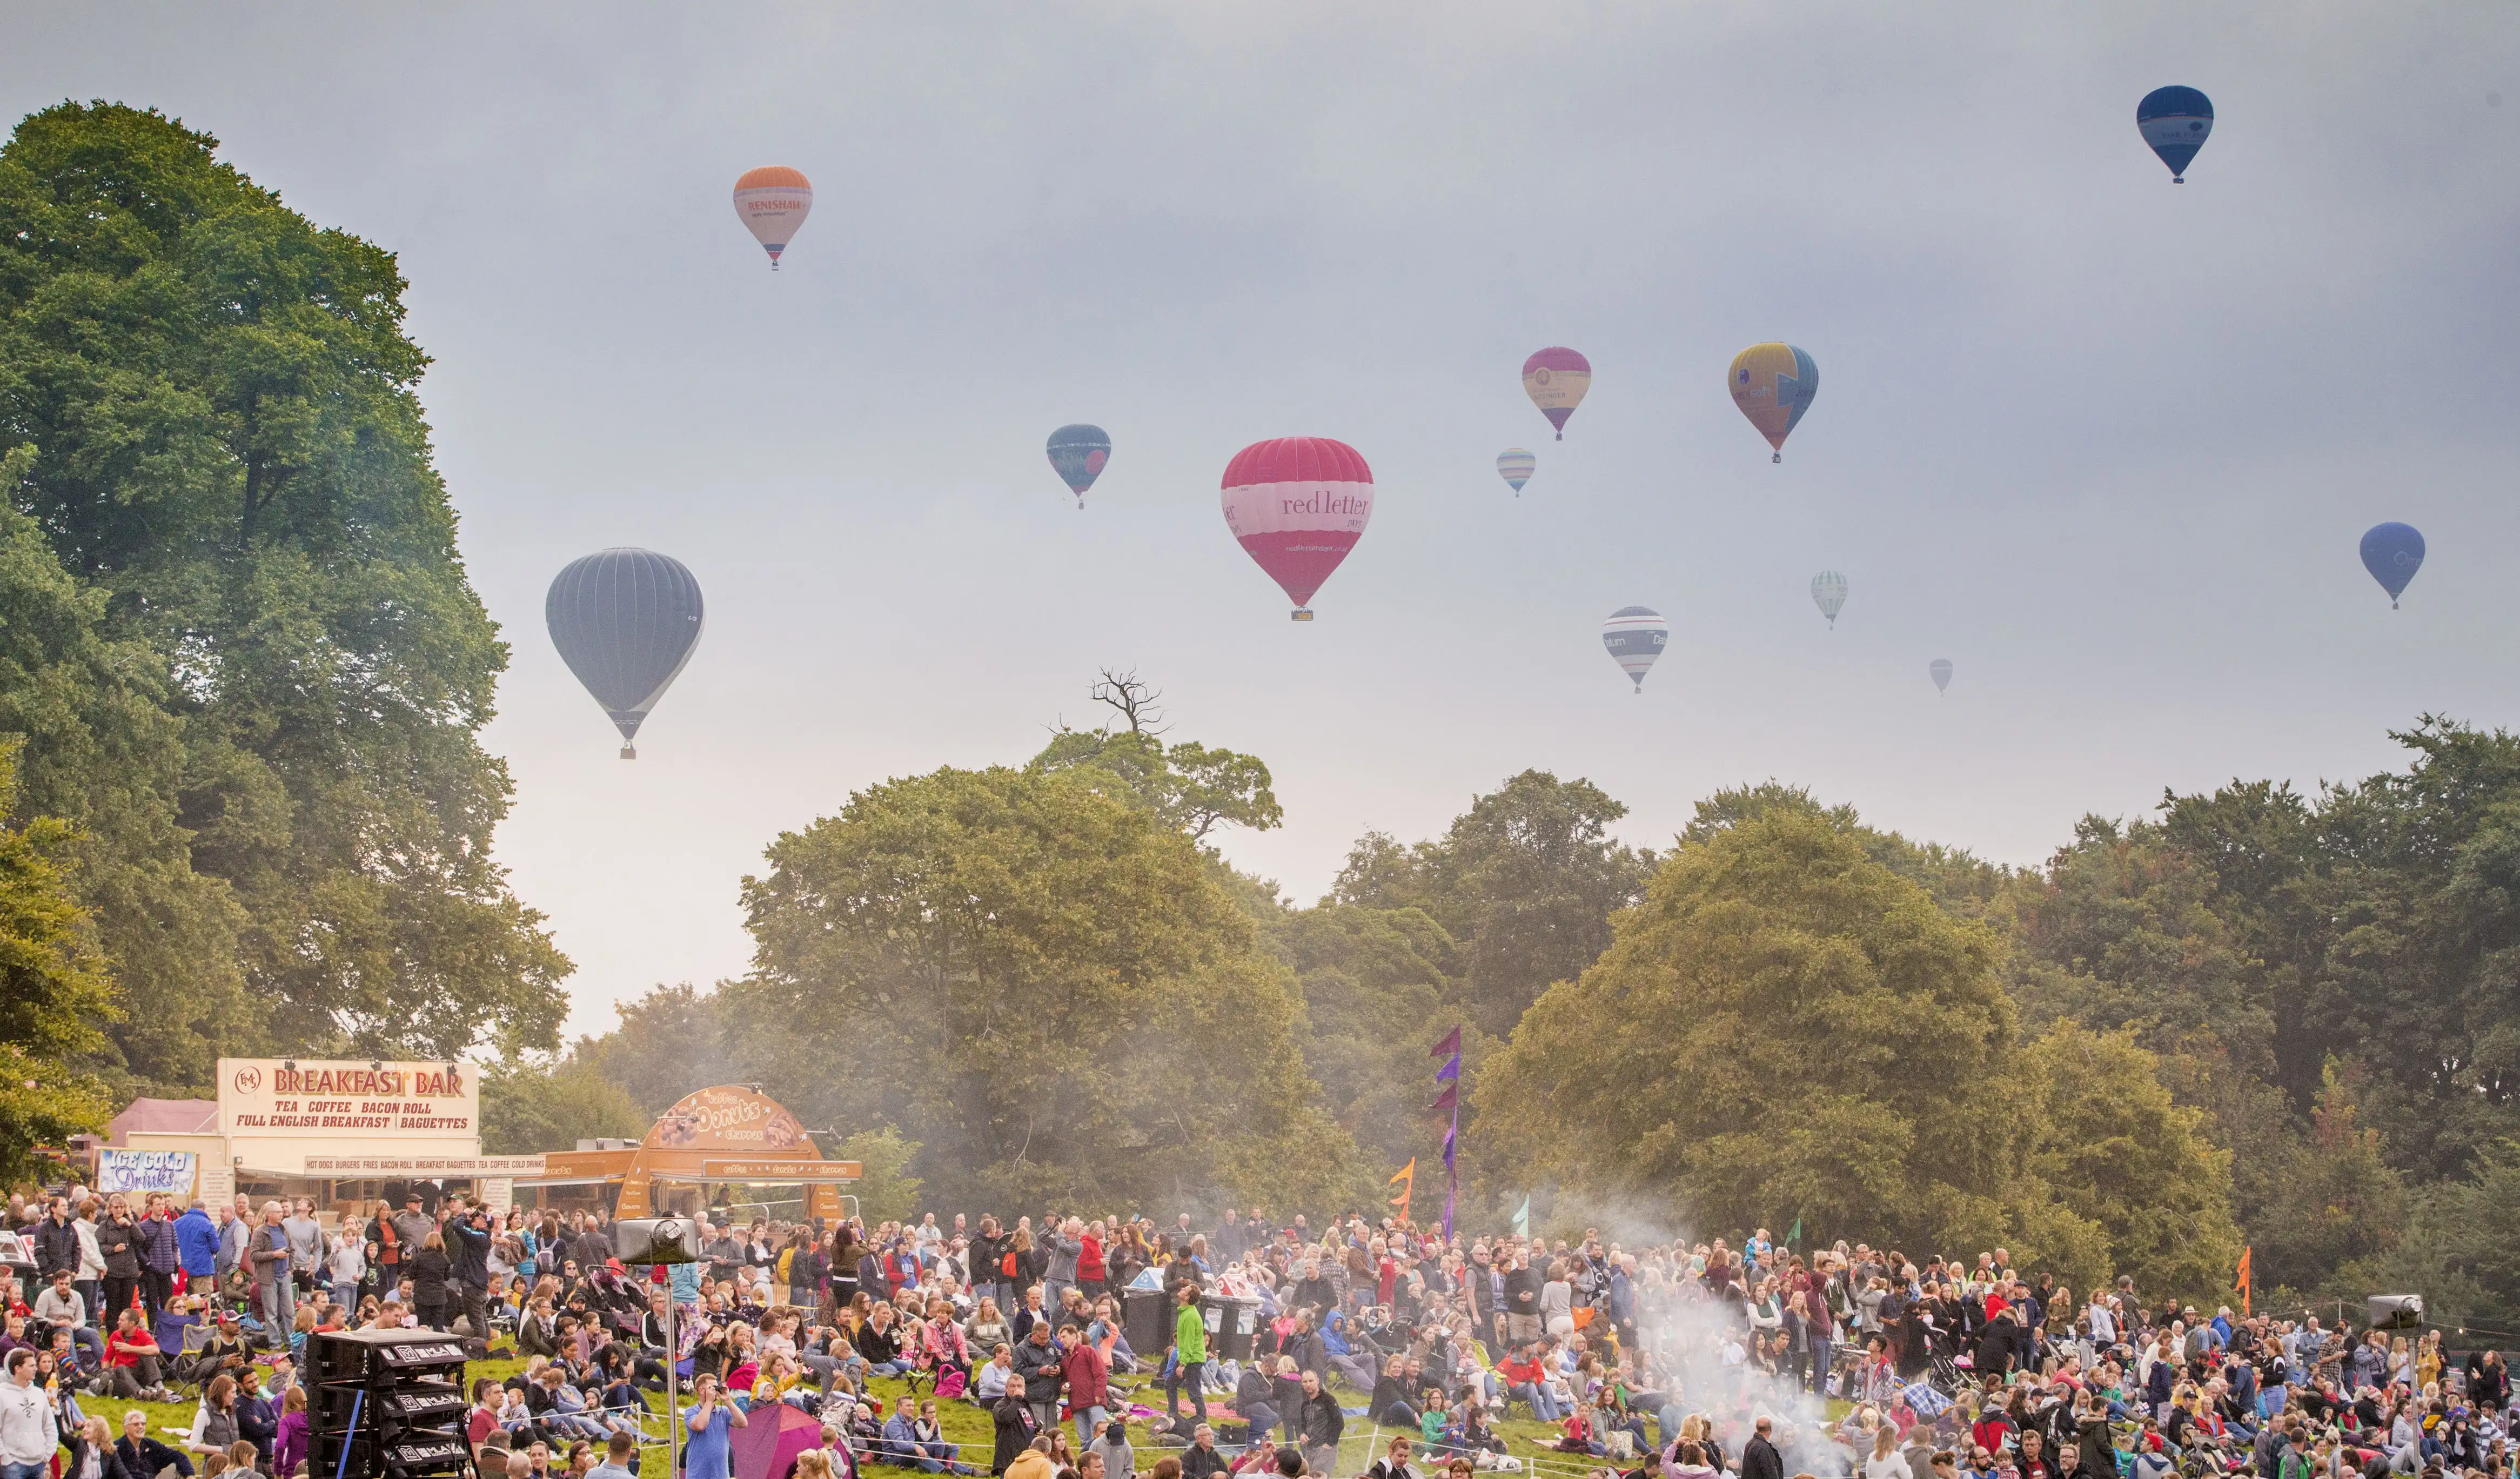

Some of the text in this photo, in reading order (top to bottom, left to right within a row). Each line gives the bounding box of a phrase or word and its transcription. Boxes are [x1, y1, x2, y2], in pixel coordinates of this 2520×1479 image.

[748, 200, 801, 211] RENISHAW
[1283, 491, 1368, 515] red letter
[1347, 519, 1362, 528] DAYS
[274, 1069, 466, 1097] BREAKFAST BAR
[708, 1092, 738, 1105] coffee
[275, 1101, 432, 1114] TEA COFFEE BACON ROLL
[237, 1115, 468, 1129] FULL ENGLISH BREAKFAST BAGUETTES
[695, 1099, 761, 1133] Donuts
[725, 1127, 763, 1140] churros
[110, 1150, 186, 1172] ICE COLD
[306, 1161, 317, 1169] HOT
[318, 1161, 333, 1169] DOGS
[336, 1161, 360, 1169] BURGERS
[363, 1161, 378, 1169] FRIES
[380, 1161, 398, 1169] BACON
[399, 1161, 412, 1169] ROLL
[415, 1161, 445, 1169] BREAKFAST
[446, 1161, 475, 1169] BAGUETTES
[512, 1160, 525, 1168] COLD
[526, 1160, 545, 1168] DRINKS
[723, 1165, 747, 1174] coffee
[773, 1165, 796, 1174] donuts
[819, 1165, 847, 1174] churros
[114, 1165, 175, 1192] Drinks
[426, 1396, 451, 1404] MLA
[426, 1445, 450, 1454] MLA
